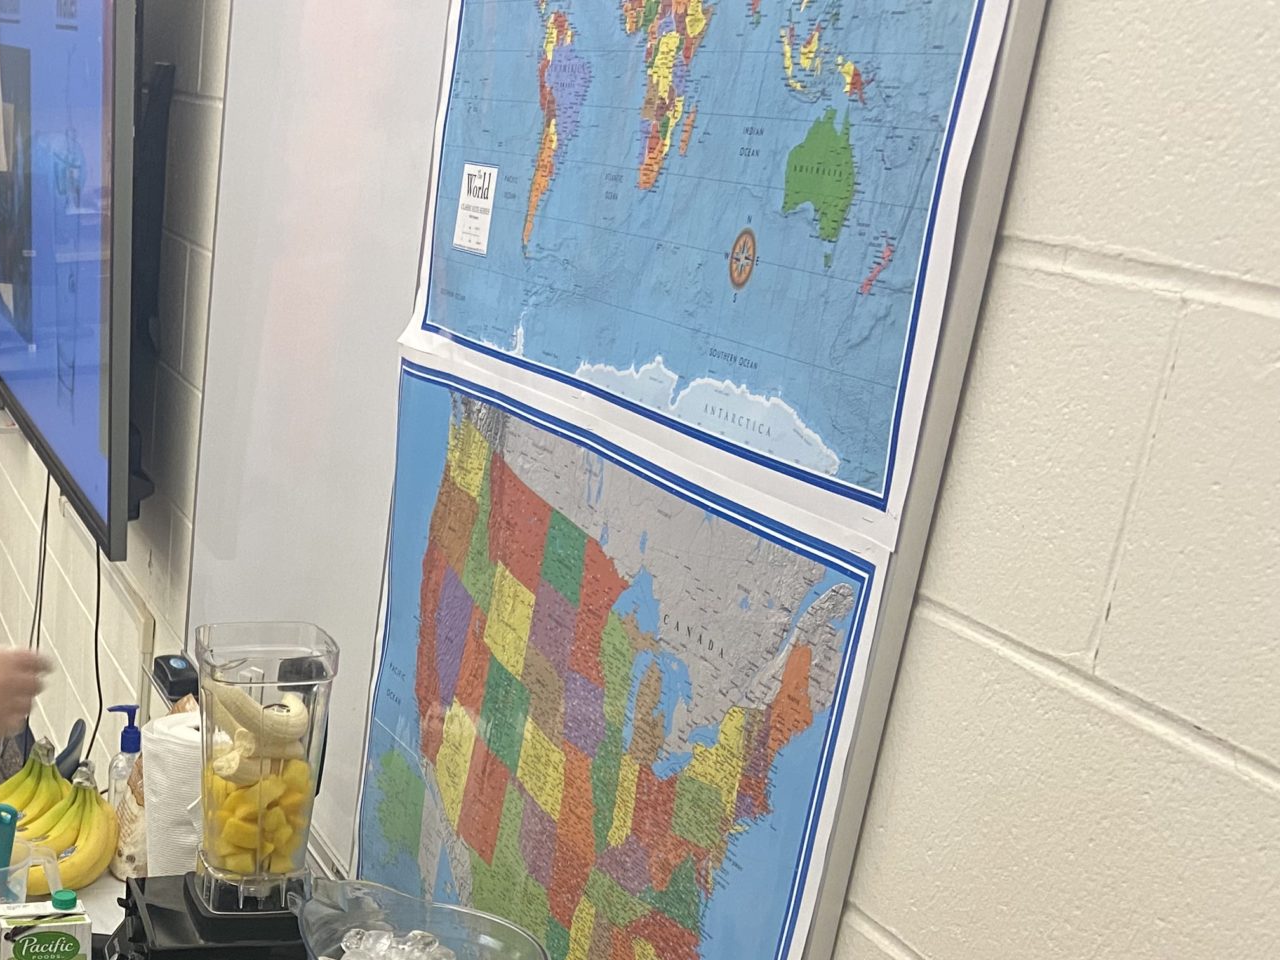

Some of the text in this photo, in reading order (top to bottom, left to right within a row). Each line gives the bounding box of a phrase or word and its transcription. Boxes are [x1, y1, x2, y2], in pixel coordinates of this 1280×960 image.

[743, 126, 764, 137] INDIAN
[739, 148, 760, 158] OCEAN
[793, 165, 843, 178] AUSTRALIA
[466, 172, 492, 200] World
[747, 216, 752, 224] N
[756, 256, 760, 266] E
[733, 292, 737, 303] S
[709, 348, 758, 370] SOUTHERN OCEAN
[704, 402, 772, 438] ANTARCTICA
[664, 614, 724, 659] CANADA
[19, 936, 74, 957] Pacific
